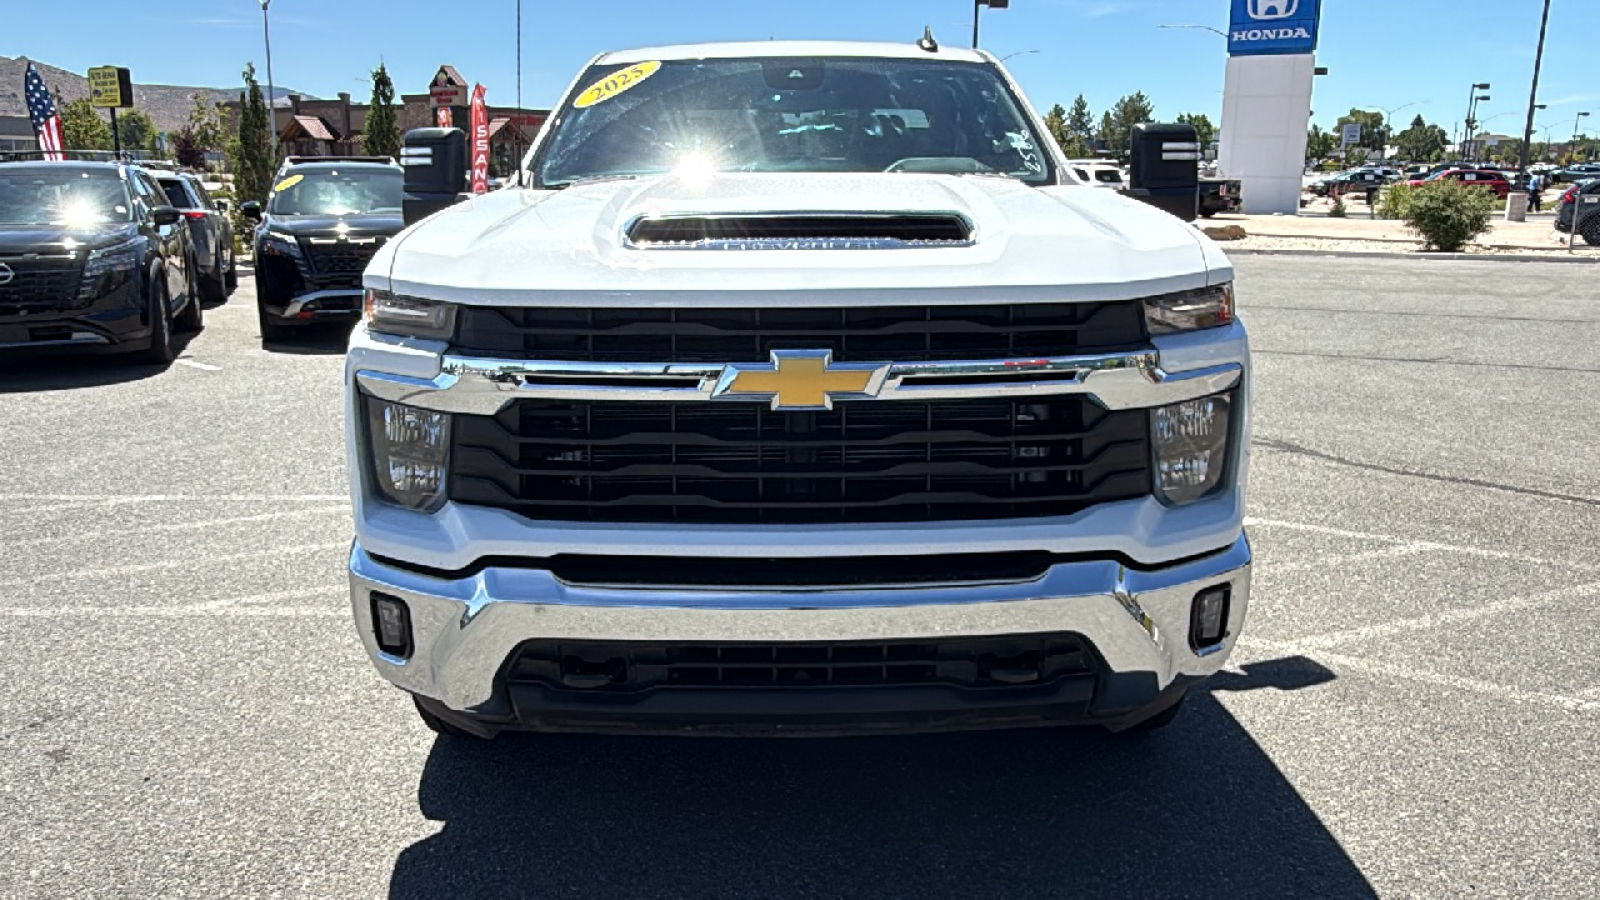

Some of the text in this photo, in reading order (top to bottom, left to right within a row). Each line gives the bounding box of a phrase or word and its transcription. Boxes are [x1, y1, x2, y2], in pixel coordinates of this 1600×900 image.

[1232, 27, 1311, 41] HONDA
[590, 68, 643, 100] 2025
[474, 98, 488, 181] NISSAN
